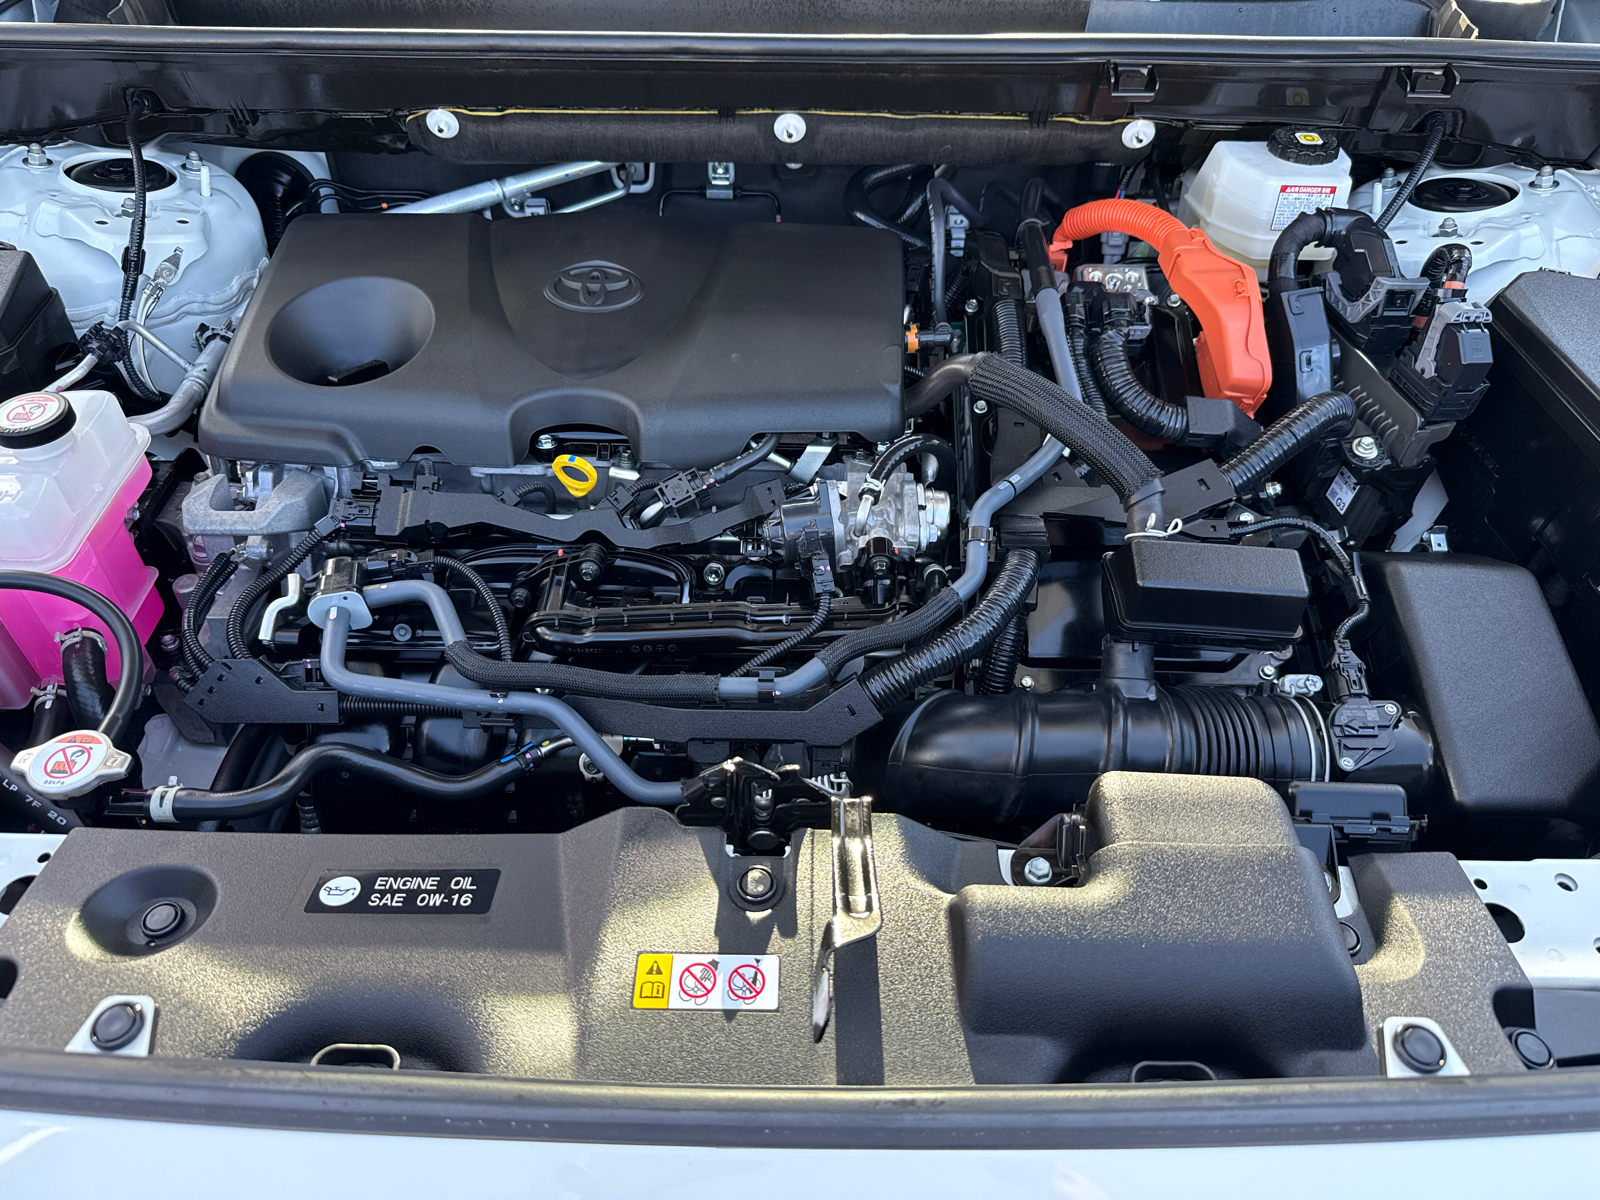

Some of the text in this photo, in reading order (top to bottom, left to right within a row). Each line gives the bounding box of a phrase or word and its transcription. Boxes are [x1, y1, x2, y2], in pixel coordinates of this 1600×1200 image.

[1335, 497, 1346, 511] G3
[2, 778, 67, 826] LP 7F 20
[374, 876, 477, 890] ENGINE OIL
[368, 893, 473, 907] SAE 0W-16
